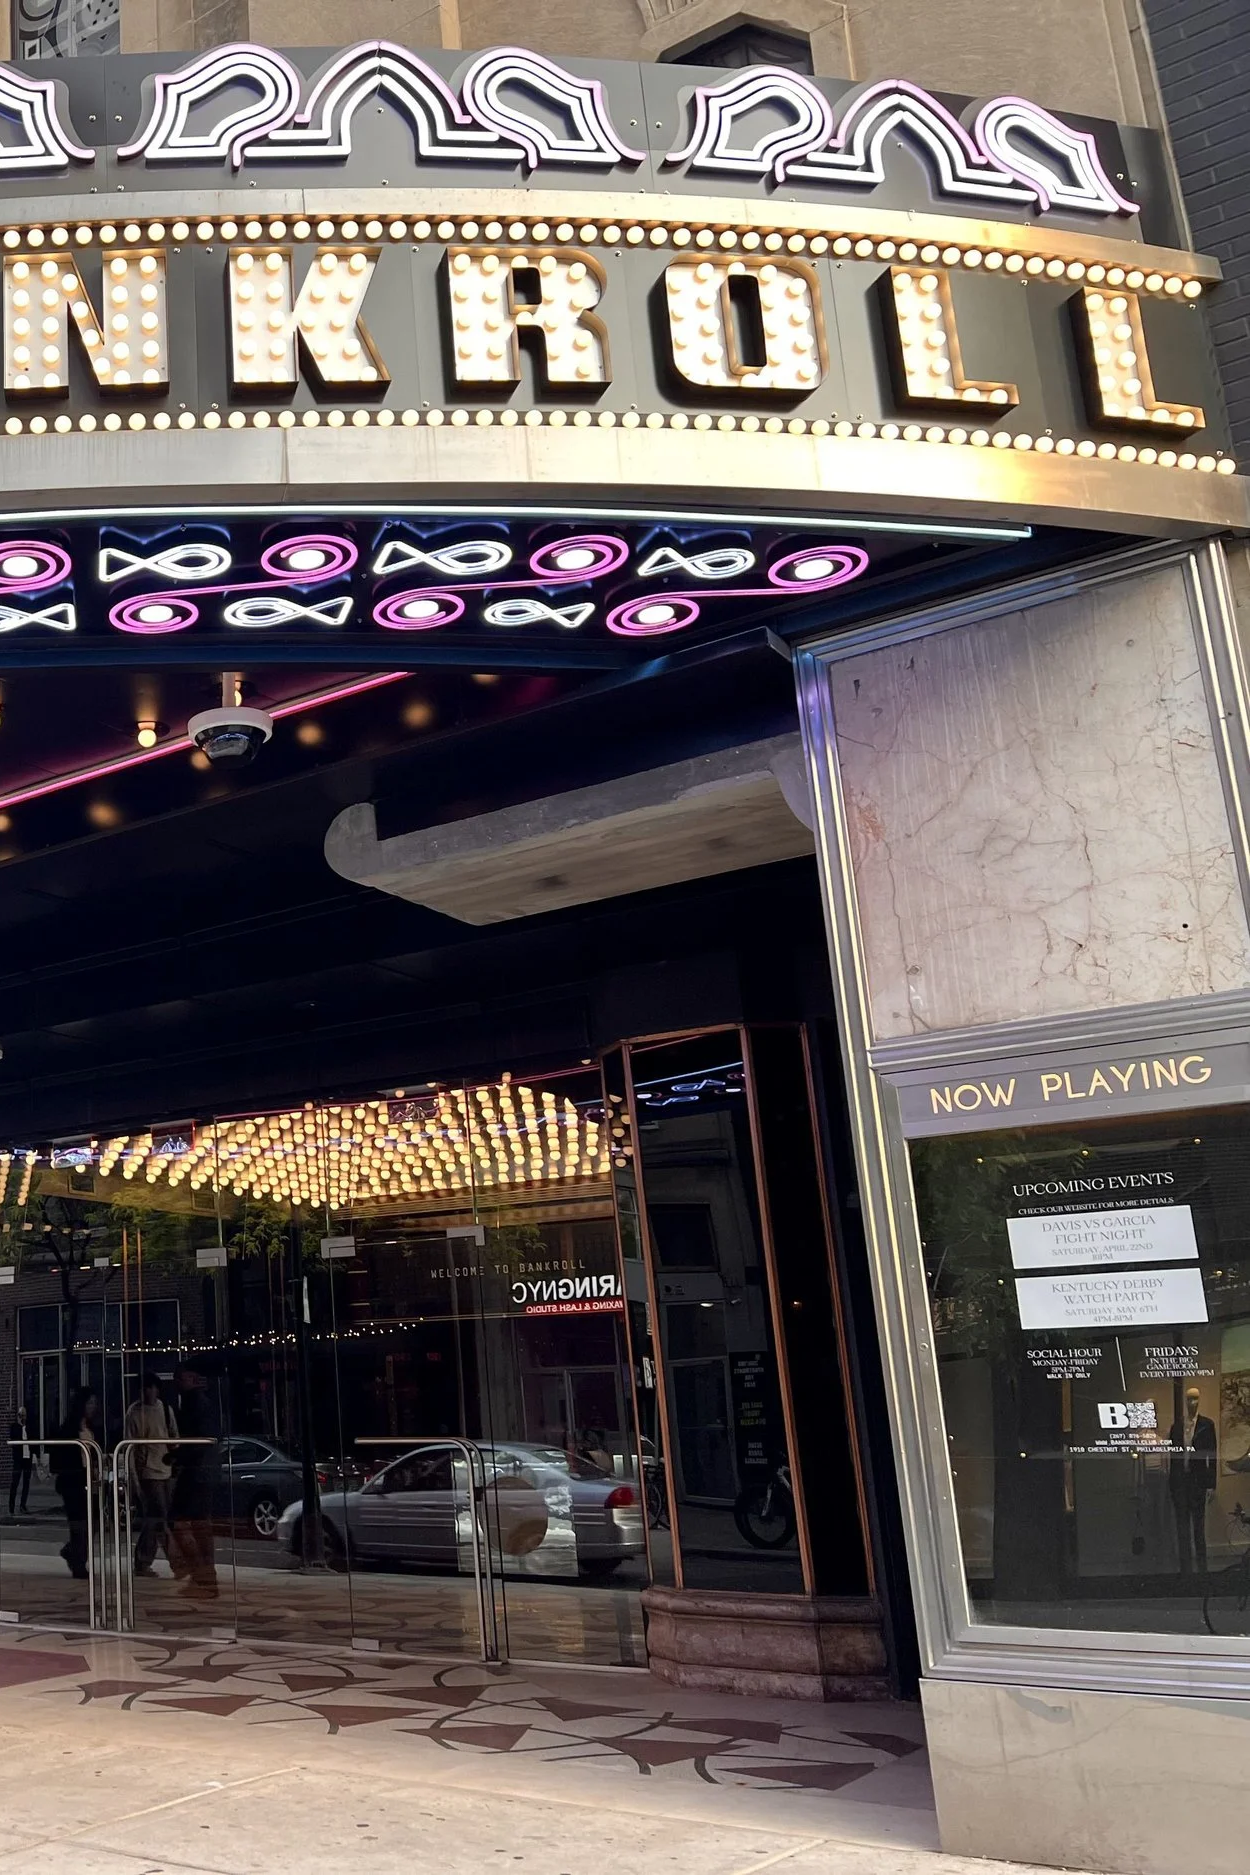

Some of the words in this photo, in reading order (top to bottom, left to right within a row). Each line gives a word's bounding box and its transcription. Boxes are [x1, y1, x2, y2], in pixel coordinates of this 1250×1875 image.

[930, 1078, 1016, 1115] NOW
[1040, 1055, 1212, 1101] PLAYING
[1013, 1178, 1104, 1197] UPCOMING
[1108, 1171, 1174, 1189] EVENTS
[1018, 1207, 1046, 1215] CHECK
[1064, 1203, 1098, 1212] WEBSITE
[1098, 1201, 1114, 1209] FOR
[1115, 1199, 1140, 1208] MORE
[1042, 1219, 1082, 1233] DAVIS
[1084, 1218, 1100, 1229] VS
[1103, 1214, 1156, 1228] GARCIA
[1055, 1231, 1098, 1245] FIGHT
[1099, 1228, 1147, 1242] NIGHT
[430, 1266, 485, 1279] WELCOME
[494, 1264, 509, 1275] TO
[519, 1259, 586, 1273] BANKROLL
[1052, 1280, 1120, 1293] KENTUCKY
[1123, 1277, 1165, 1289] DERBY
[1063, 1292, 1112, 1305] WATCH
[1114, 1290, 1157, 1303] PARTY
[1026, 1349, 1067, 1359] SOCIAL
[1068, 1347, 1103, 1357] HOUR
[1145, 1346, 1199, 1357] FRIDAYS
[1032, 1358, 1099, 1367] MONDAY-FRIDAY
